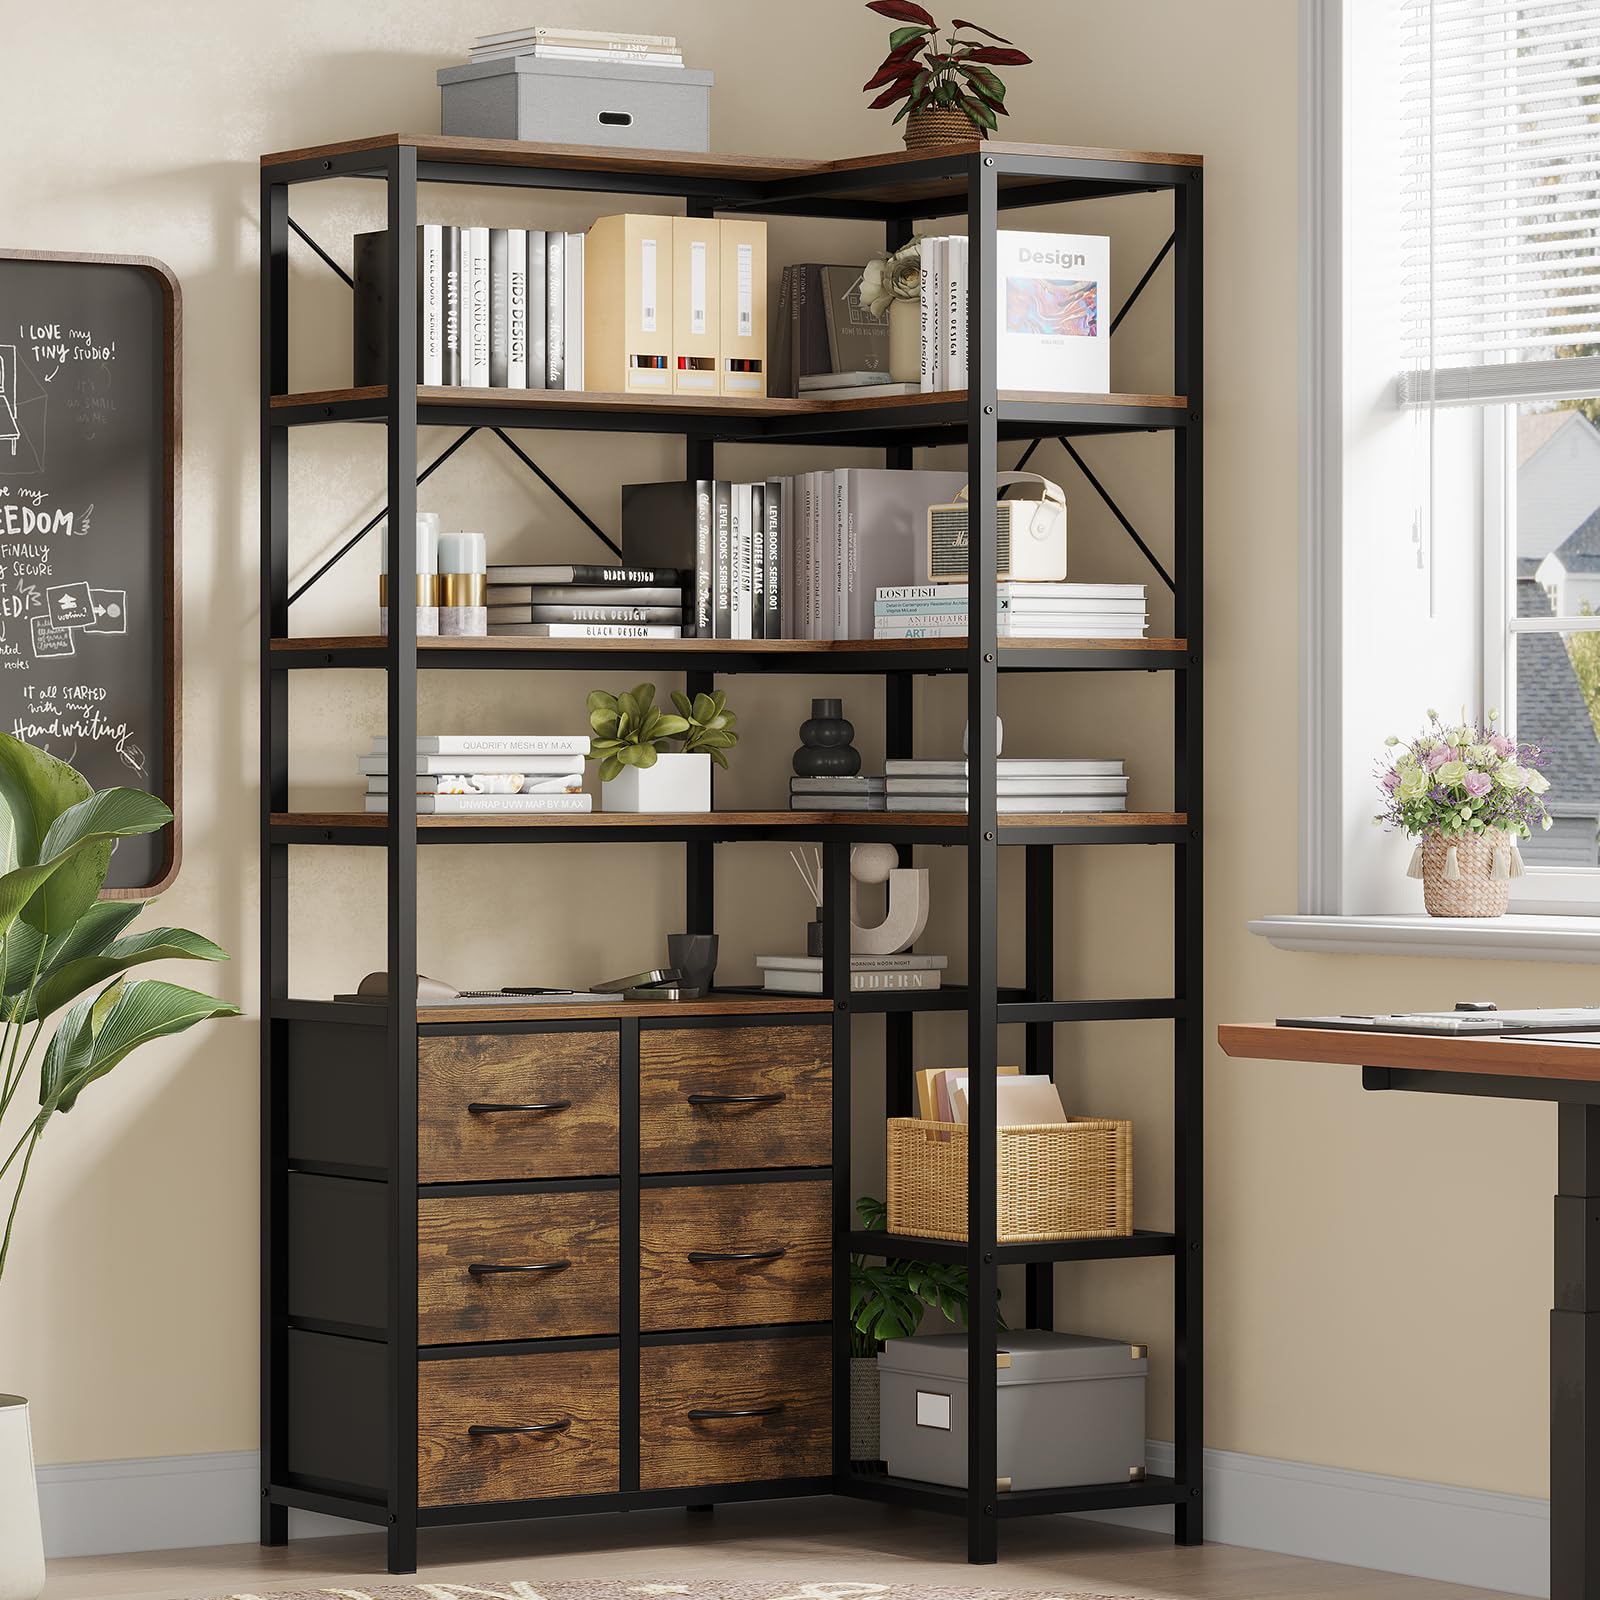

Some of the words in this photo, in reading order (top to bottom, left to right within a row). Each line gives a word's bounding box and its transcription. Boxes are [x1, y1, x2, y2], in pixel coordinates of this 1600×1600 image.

[1018, 247, 1086, 269] Design
[447, 271, 458, 304] BLACK
[512, 272, 524, 305] KIDS
[921, 296, 928, 309] of
[20, 325, 24, 338] I
[30, 324, 62, 340] LOVE
[68, 329, 92, 346] my
[447, 310, 458, 349] DESIGN
[512, 309, 524, 363] DESIGN
[18, 487, 49, 507] my
[719, 504, 728, 528] LEVEL
[769, 505, 778, 530] LEVEL
[719, 530, 728, 559] BOOKS
[753, 531, 763, 564] COFFEE
[769, 532, 778, 560] BOOKS
[13, 561, 53, 576] SECURE
[741, 535, 750, 592] MINIMALISM
[603, 569, 626, 582] BLACK
[628, 571, 655, 583] DESIGN
[719, 565, 728, 593] SERIES
[753, 566, 763, 594] ATLAS
[769, 566, 778, 594] SERIES
[719, 594, 728, 610] 001
[769, 595, 778, 610] 001
[880, 589, 908, 599] LOST
[911, 588, 936, 598] FISH
[572, 609, 607, 621] SILVER
[611, 609, 647, 622] DESIGN
[698, 589, 709, 628] Posada
[586, 626, 613, 637] BLACK
[617, 627, 649, 637] DESIGN
[905, 628, 927, 638] ART
[4, 658, 30, 670] notes
[23, 685, 35, 699] IT
[39, 685, 57, 699] all
[27, 701, 62, 716] with
[66, 702, 94, 719] my
[11, 710, 134, 753] Handwriting
[463, 741, 509, 750] QUADRIFY
[510, 741, 535, 750] MESH
[537, 741, 549, 750] BY
[459, 800, 500, 809] UNWRAP
[502, 800, 524, 809] UVW
[525, 800, 545, 809] MAP
[547, 800, 558, 809] BY
[854, 974, 923, 989] ODERN
